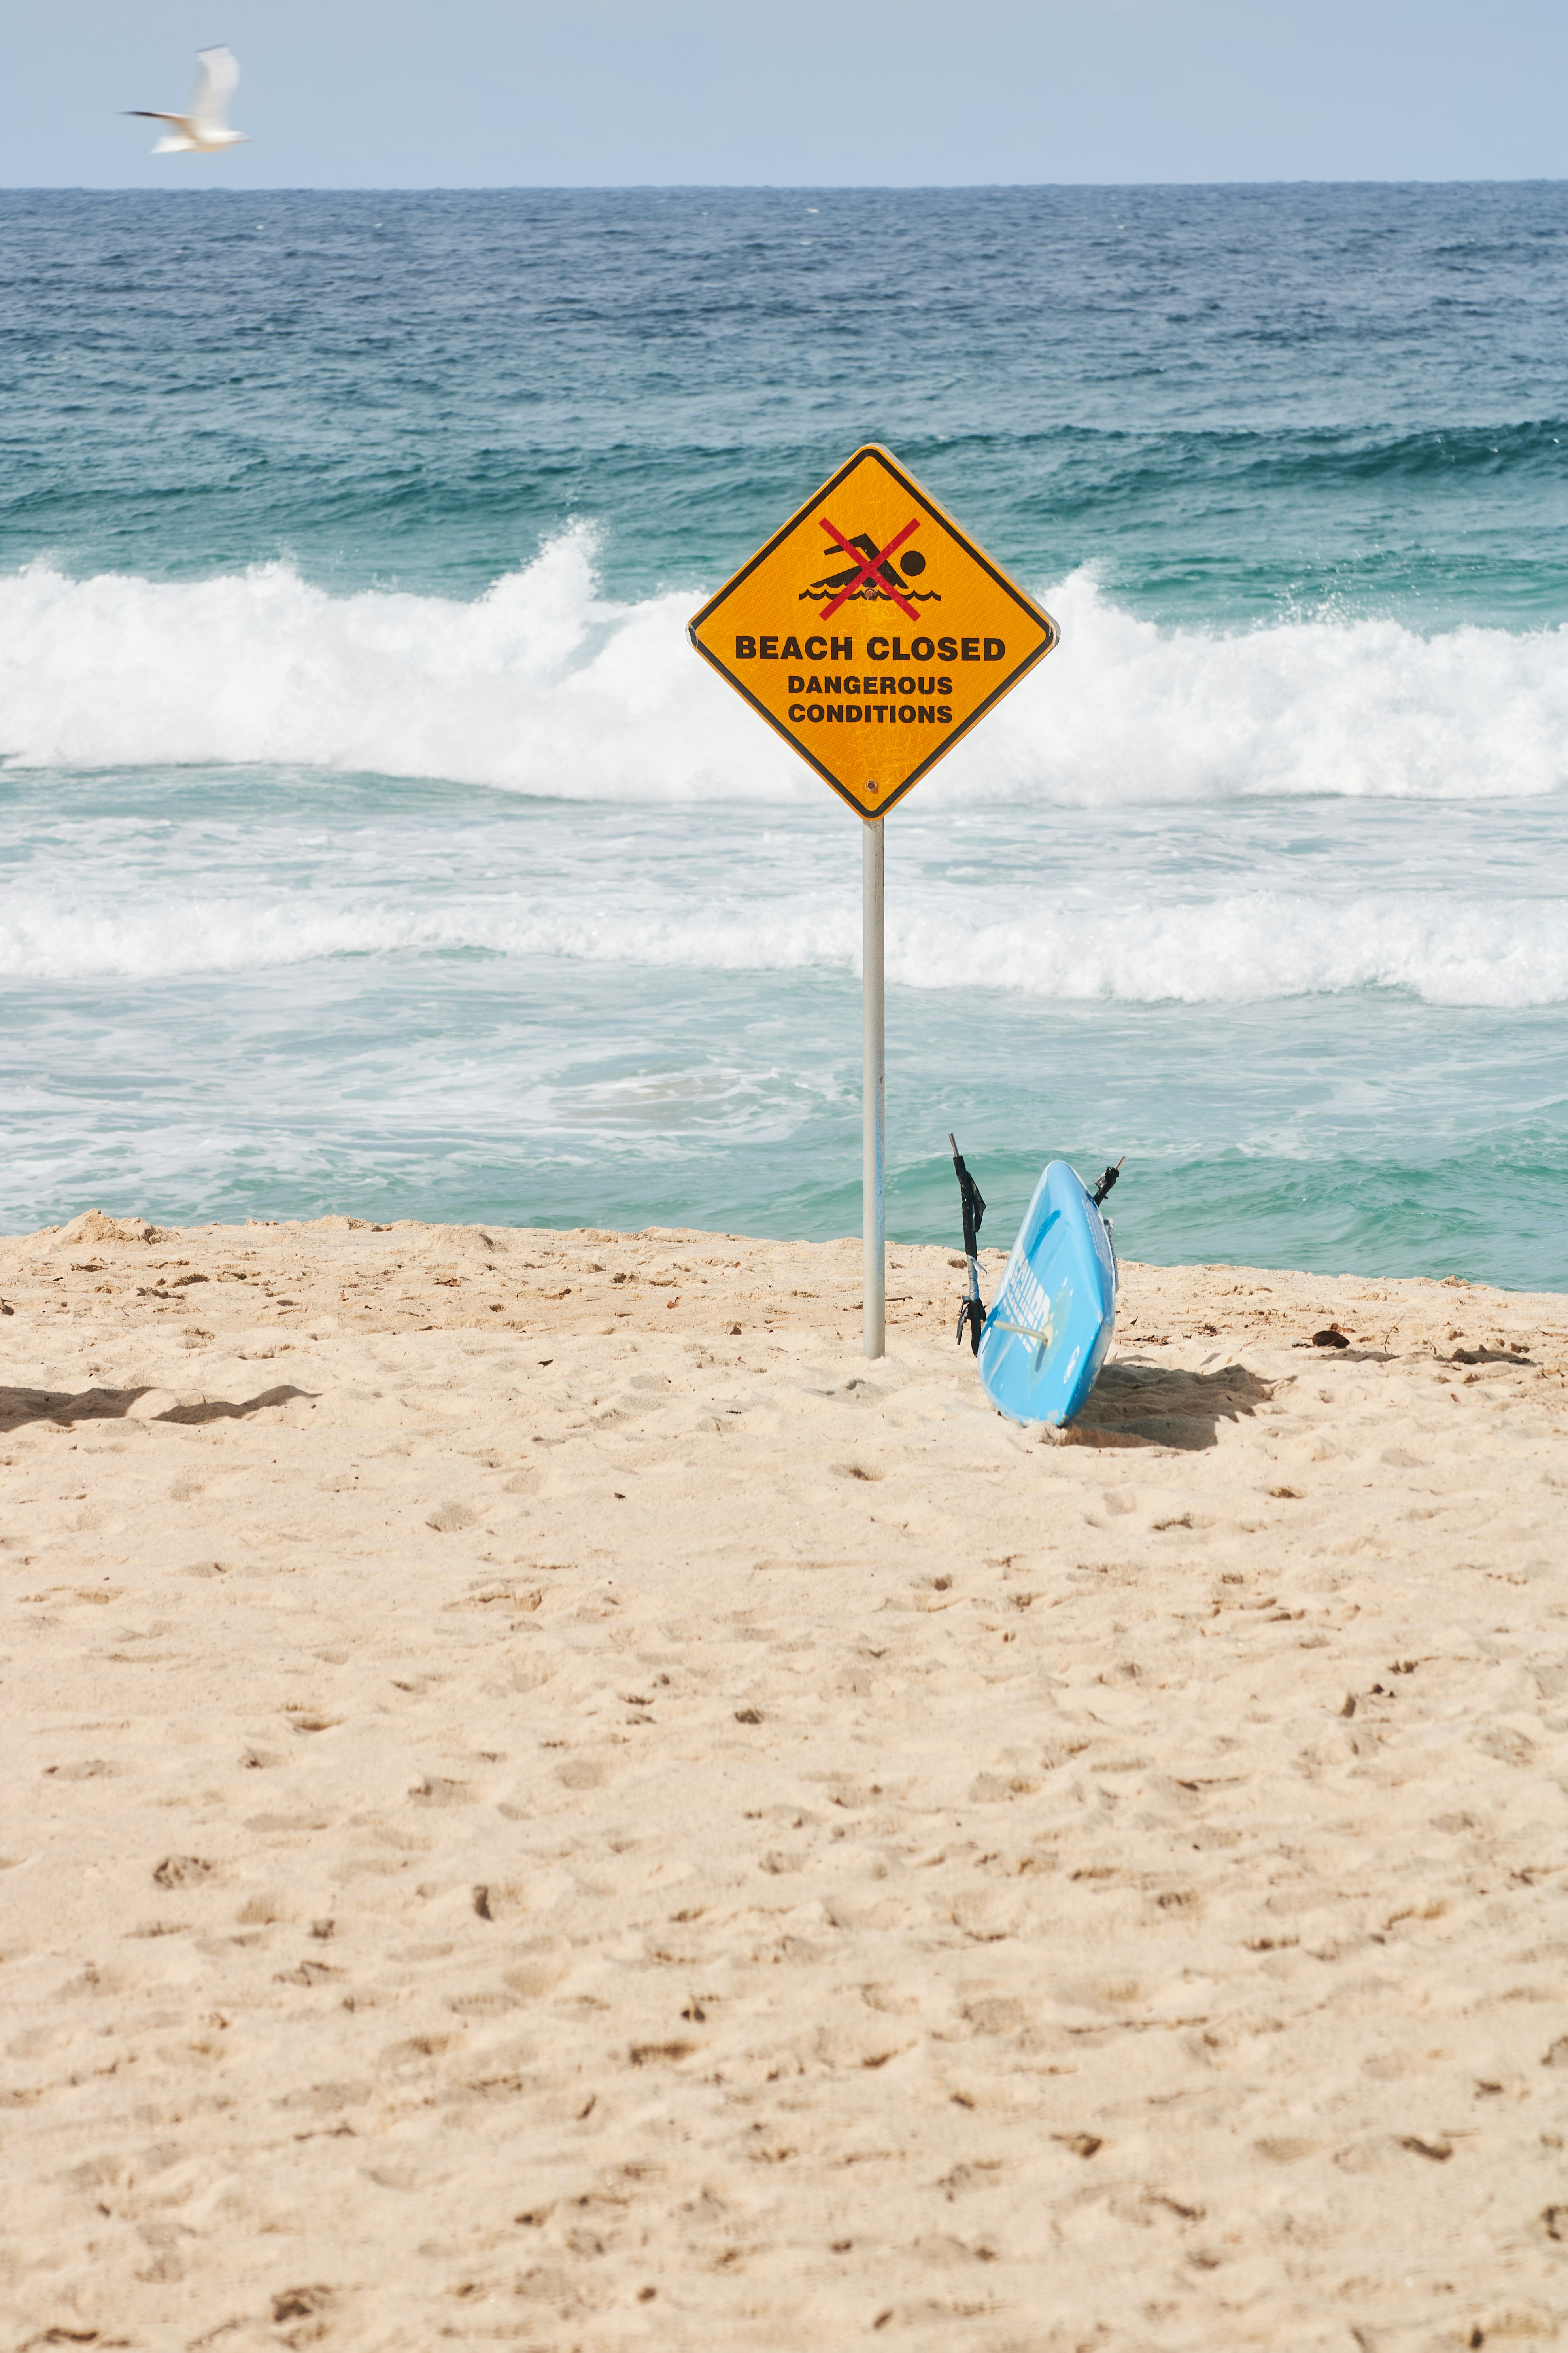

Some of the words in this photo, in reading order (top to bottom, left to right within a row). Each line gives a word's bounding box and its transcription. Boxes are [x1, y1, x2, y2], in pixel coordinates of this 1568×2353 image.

[736, 636, 852, 660] BEACH
[867, 636, 1005, 661] CLOSED
[788, 676, 953, 695] DANGEROUS
[788, 704, 953, 723] CONDITIONS
